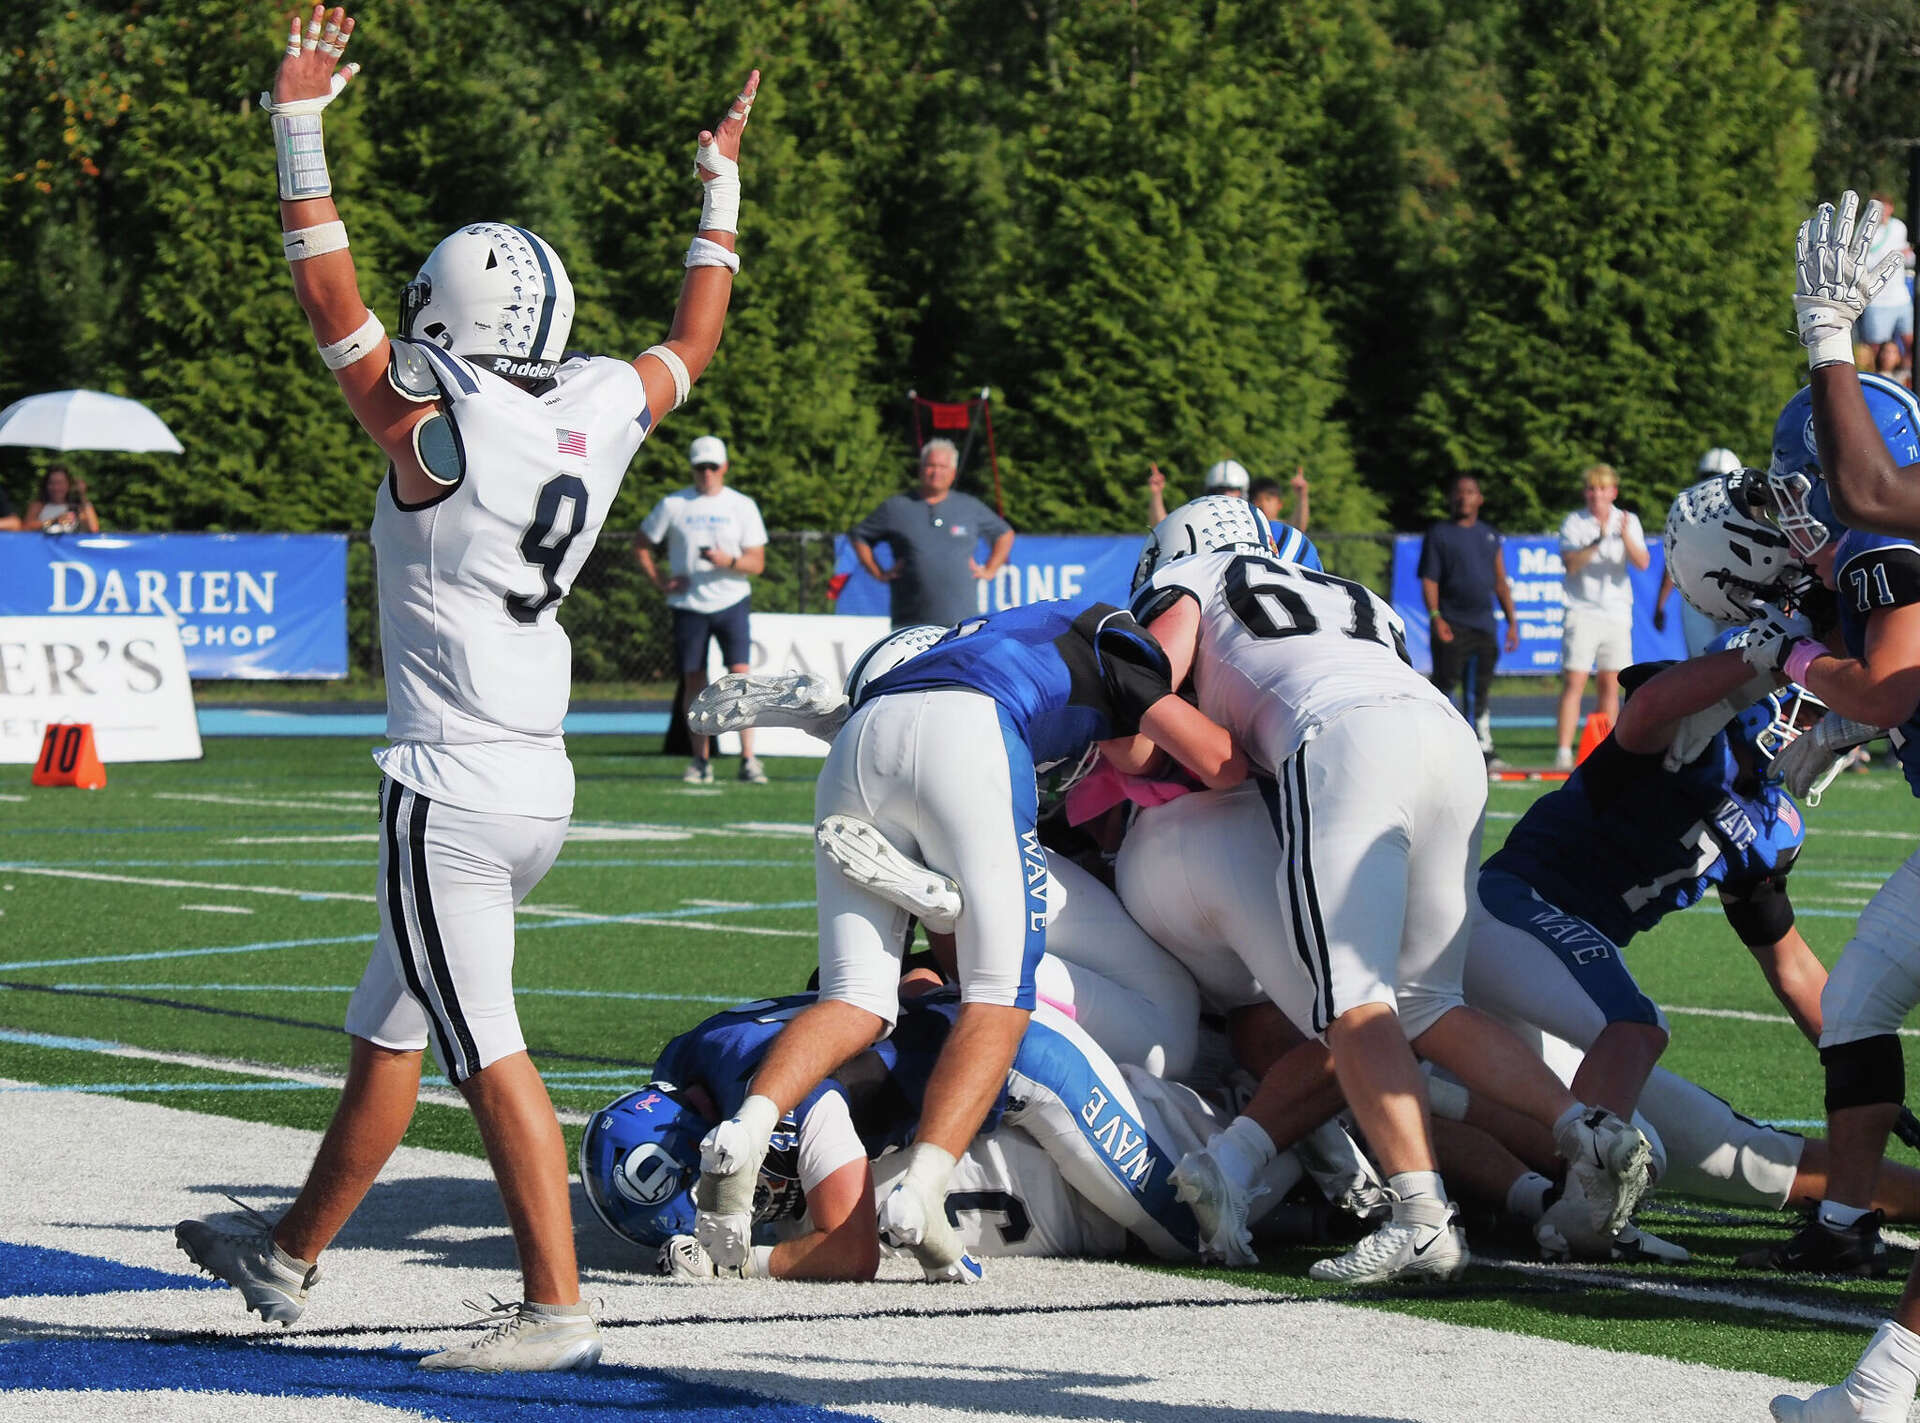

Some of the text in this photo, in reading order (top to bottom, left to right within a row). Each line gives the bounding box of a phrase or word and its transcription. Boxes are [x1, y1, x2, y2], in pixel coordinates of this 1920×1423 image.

[503, 472, 589, 627] 9
[1850, 563, 1895, 612] 71
[48, 561, 278, 624] DARIEN
[1221, 555, 1390, 648] 67
[180, 625, 277, 646] SHOP
[43, 726, 82, 773] 10
[1020, 829, 1047, 933] WAVE
[1621, 819, 1721, 912] 7
[1529, 910, 1610, 965] WAVE
[1081, 1086, 1158, 1193] WAVE
